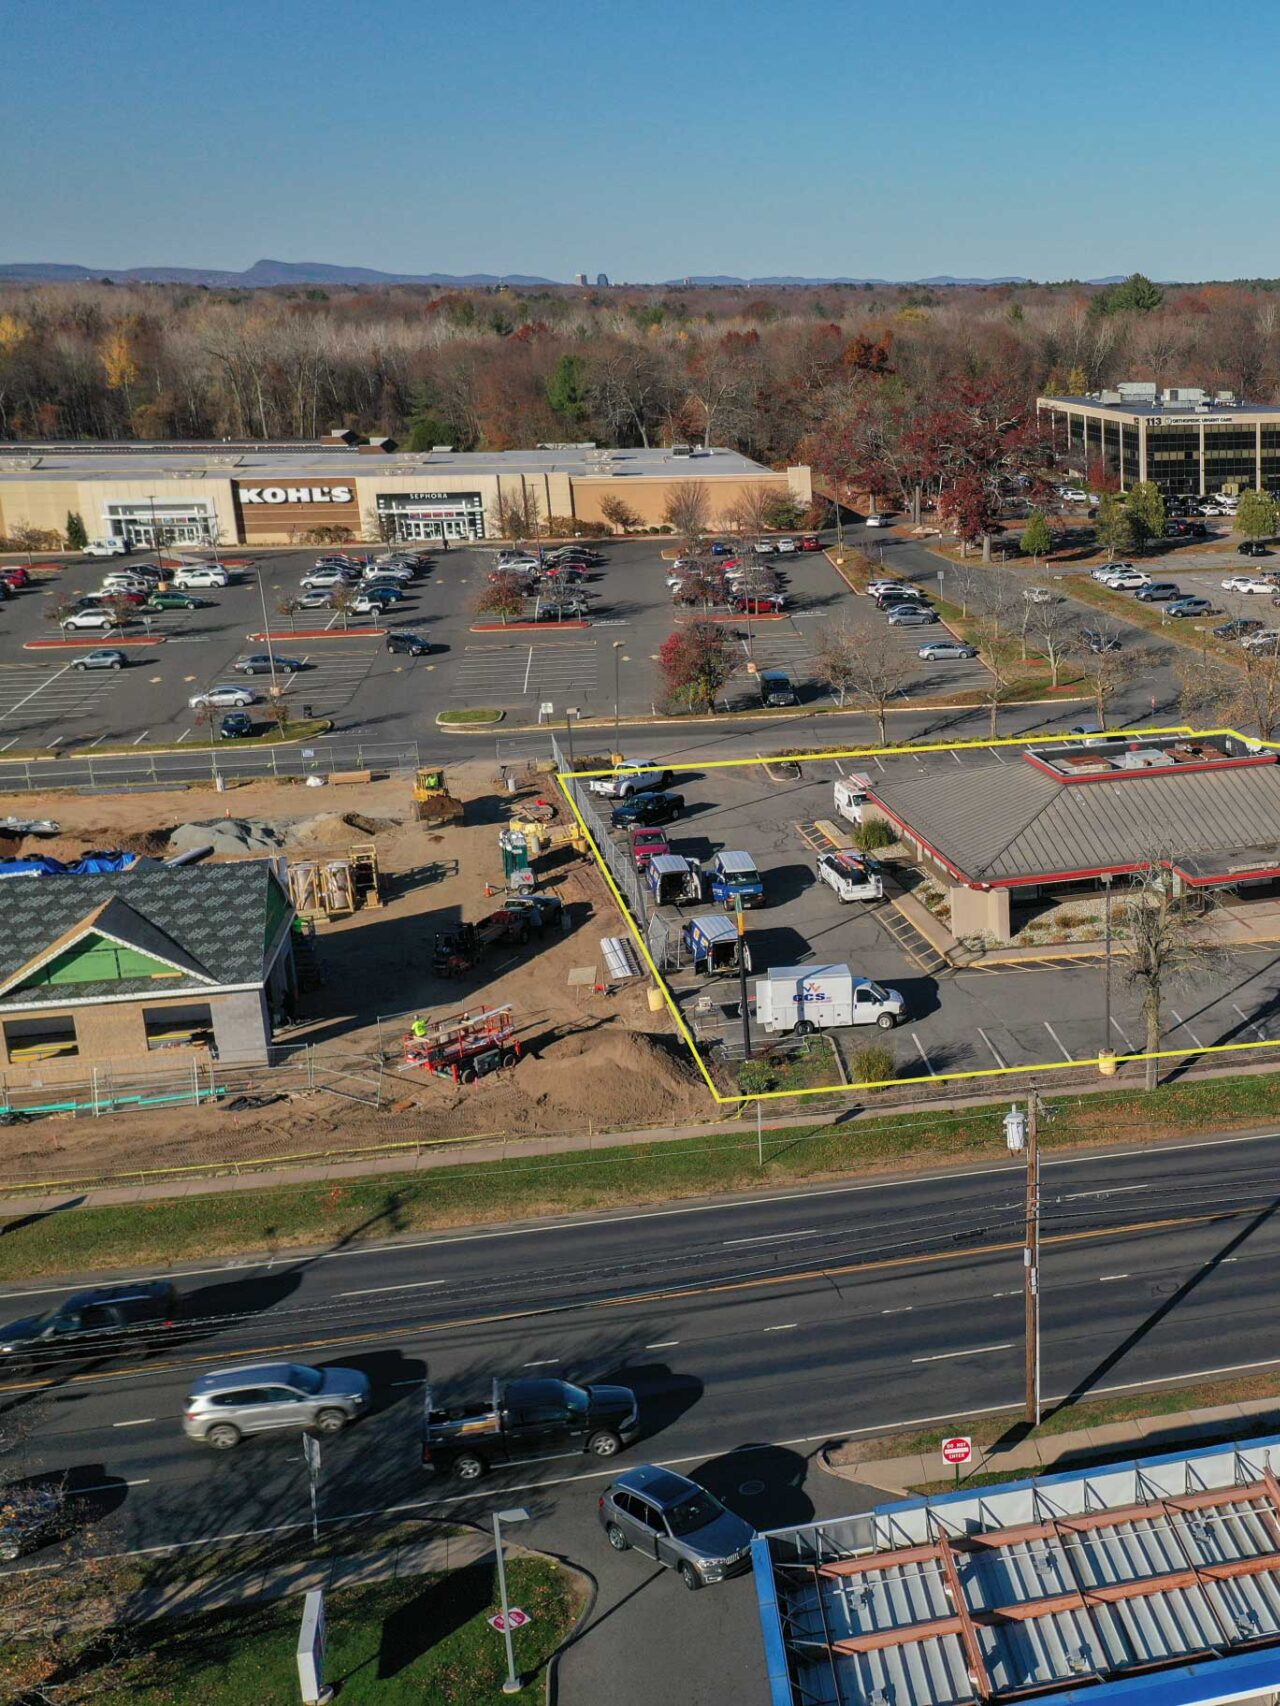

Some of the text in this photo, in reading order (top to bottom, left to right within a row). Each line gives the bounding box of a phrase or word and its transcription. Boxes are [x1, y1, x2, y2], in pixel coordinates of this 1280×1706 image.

[1145, 417, 1162, 426] 113
[239, 487, 351, 504] KOHL'S
[409, 492, 448, 500] SEPHORA
